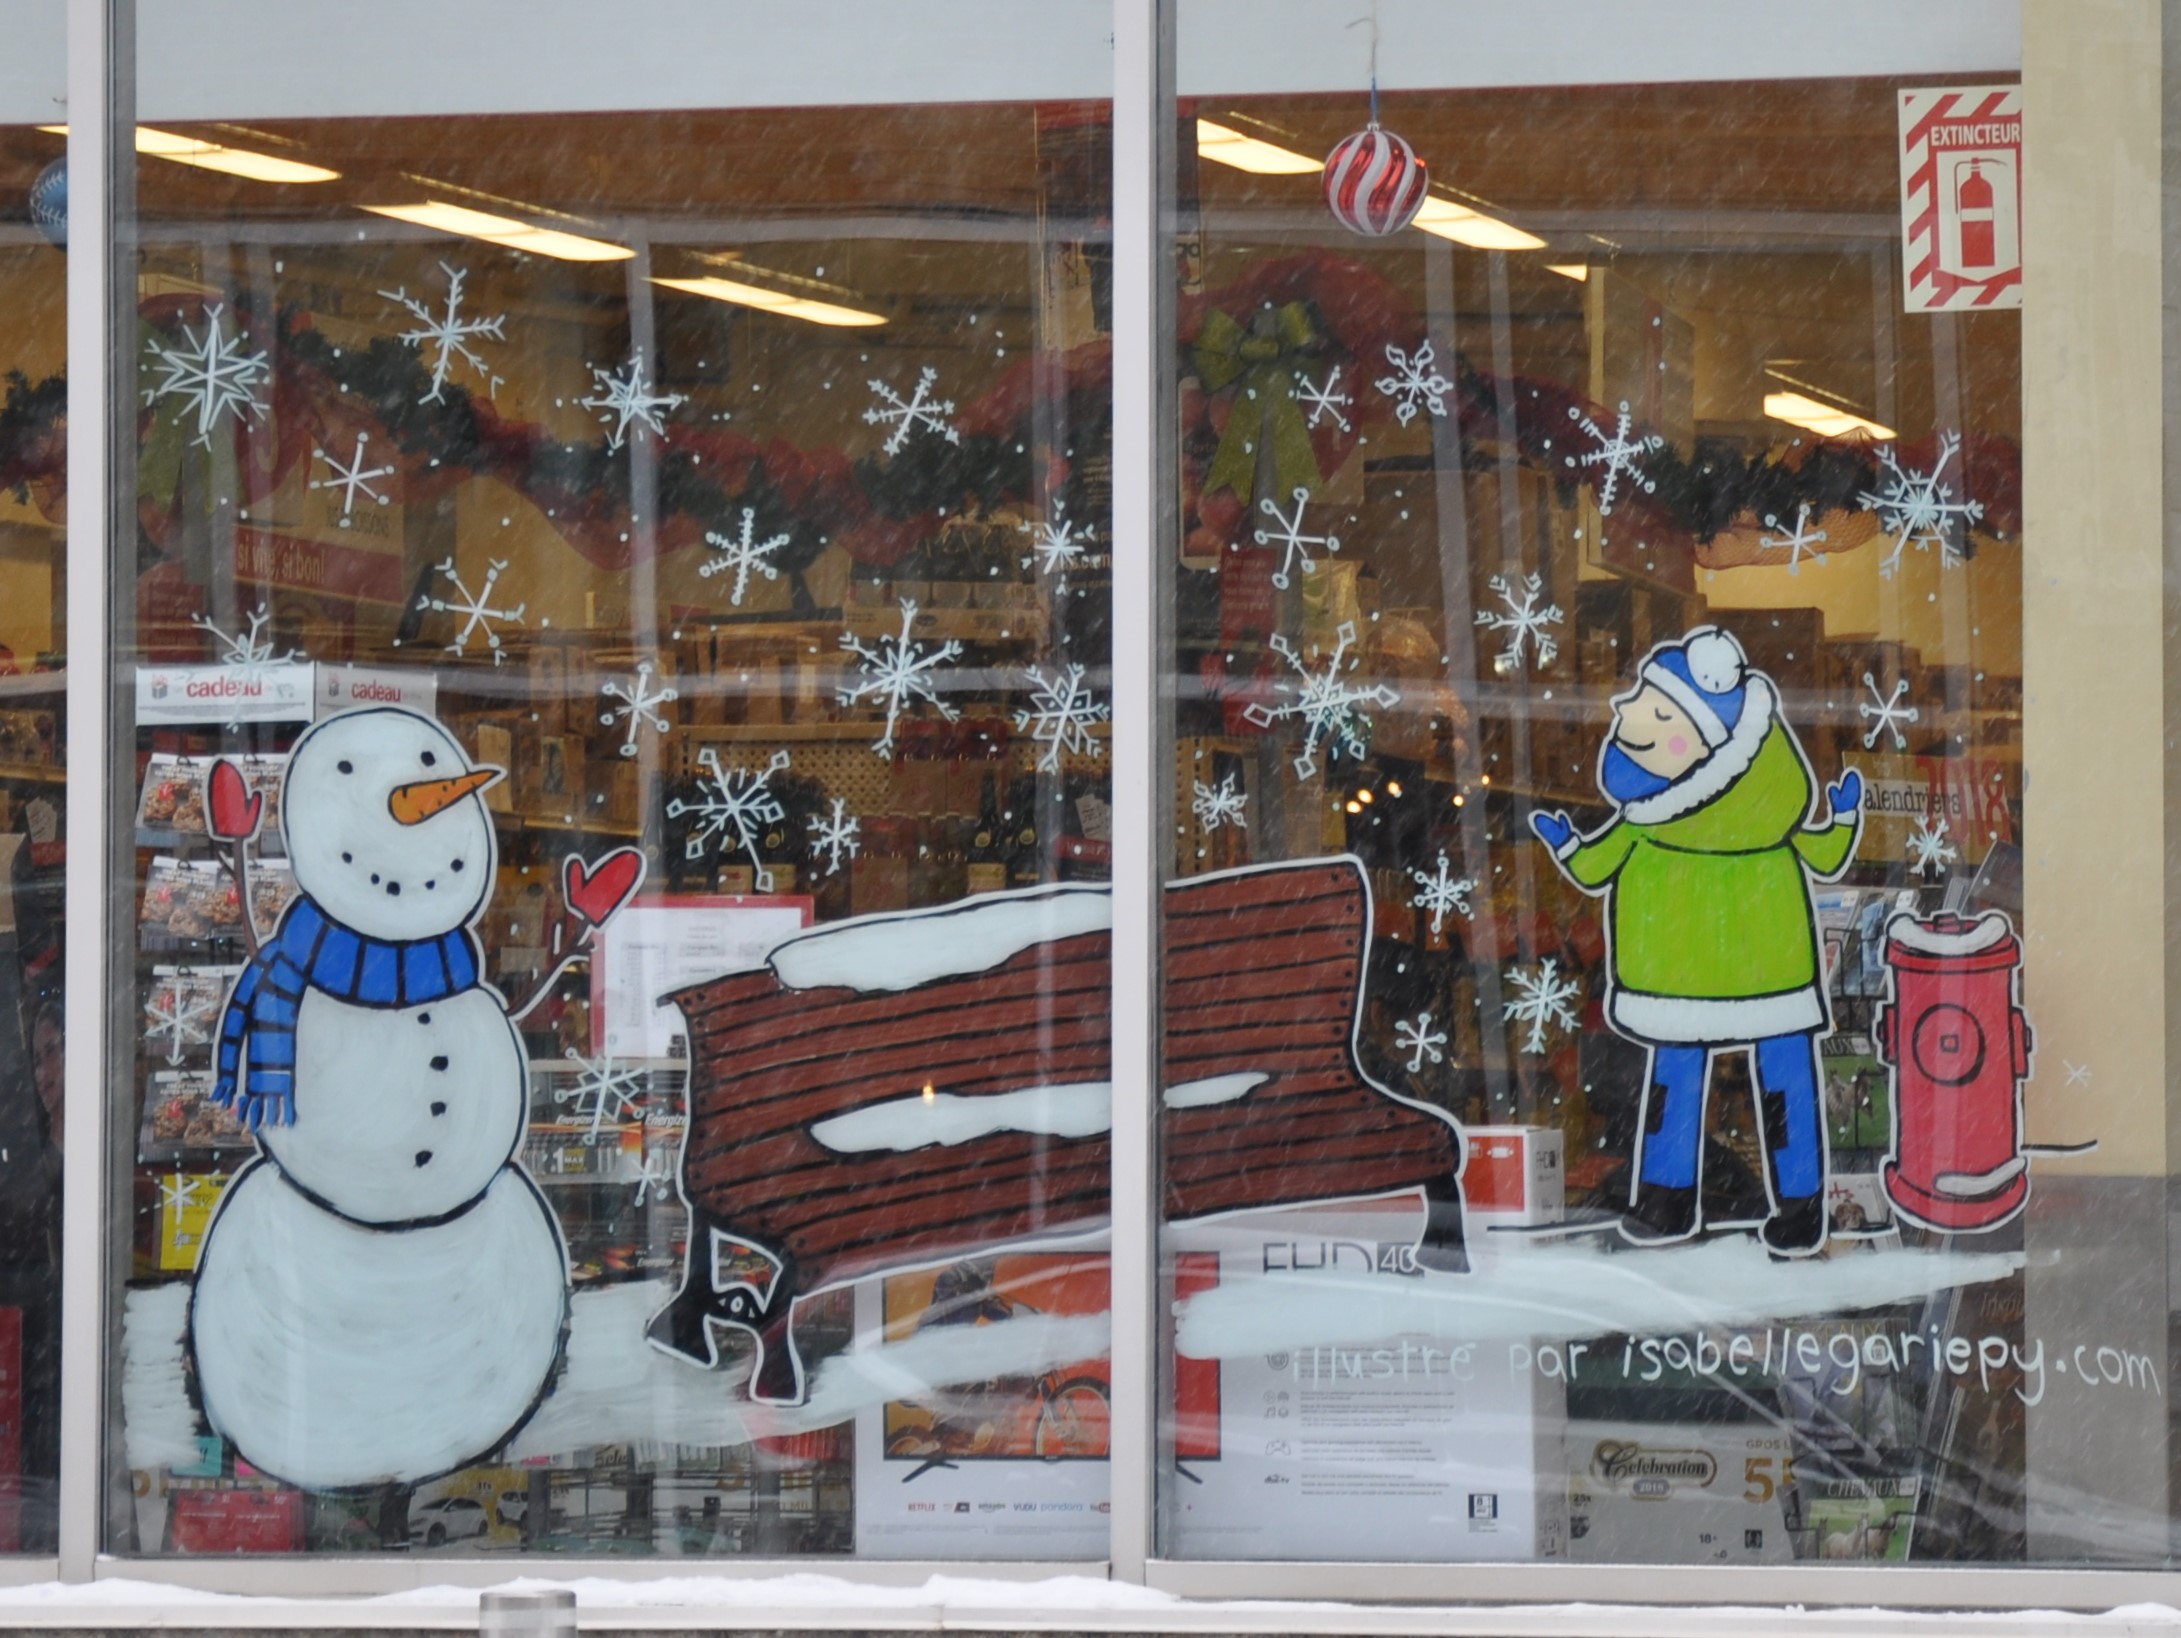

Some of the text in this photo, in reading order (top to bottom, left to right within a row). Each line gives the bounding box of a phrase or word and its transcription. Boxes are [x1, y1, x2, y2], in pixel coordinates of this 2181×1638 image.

[1931, 123, 2021, 147] EXTINCTEUR
[351, 679, 401, 703] cadeau
[1864, 783, 1961, 815] alendriers
[1508, 1342, 1588, 1388] par
[1622, 1327, 2161, 1406] isabellegariepy.com
[1746, 1440, 1781, 1450] GROS
[1827, 1477, 1901, 1498] CHEVAUX
[1013, 1502, 1037, 1512] VUDU
[1040, 1502, 1083, 1513] pandora
